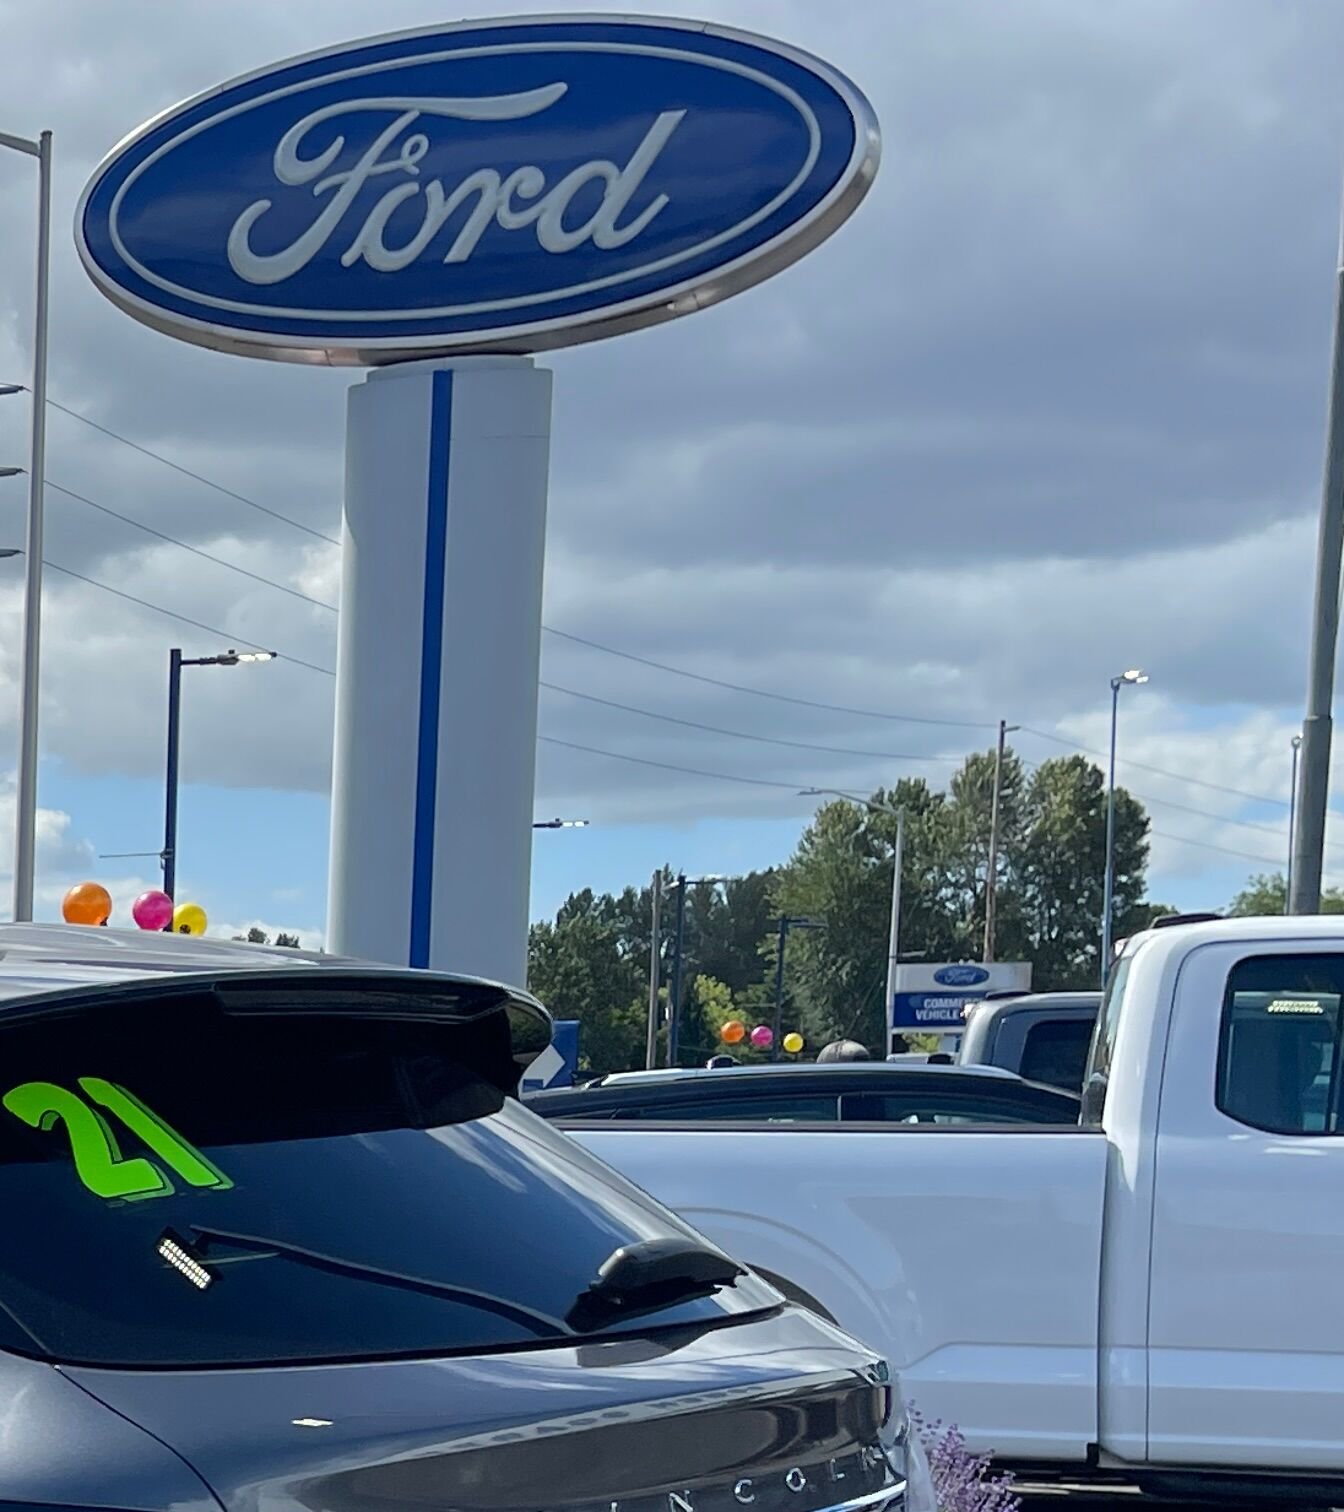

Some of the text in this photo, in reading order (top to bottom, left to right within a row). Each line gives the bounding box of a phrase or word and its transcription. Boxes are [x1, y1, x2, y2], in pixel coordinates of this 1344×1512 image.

[227, 81, 687, 285] Ford
[944, 968, 977, 984] Ford
[2, 1077, 234, 1205] 21
